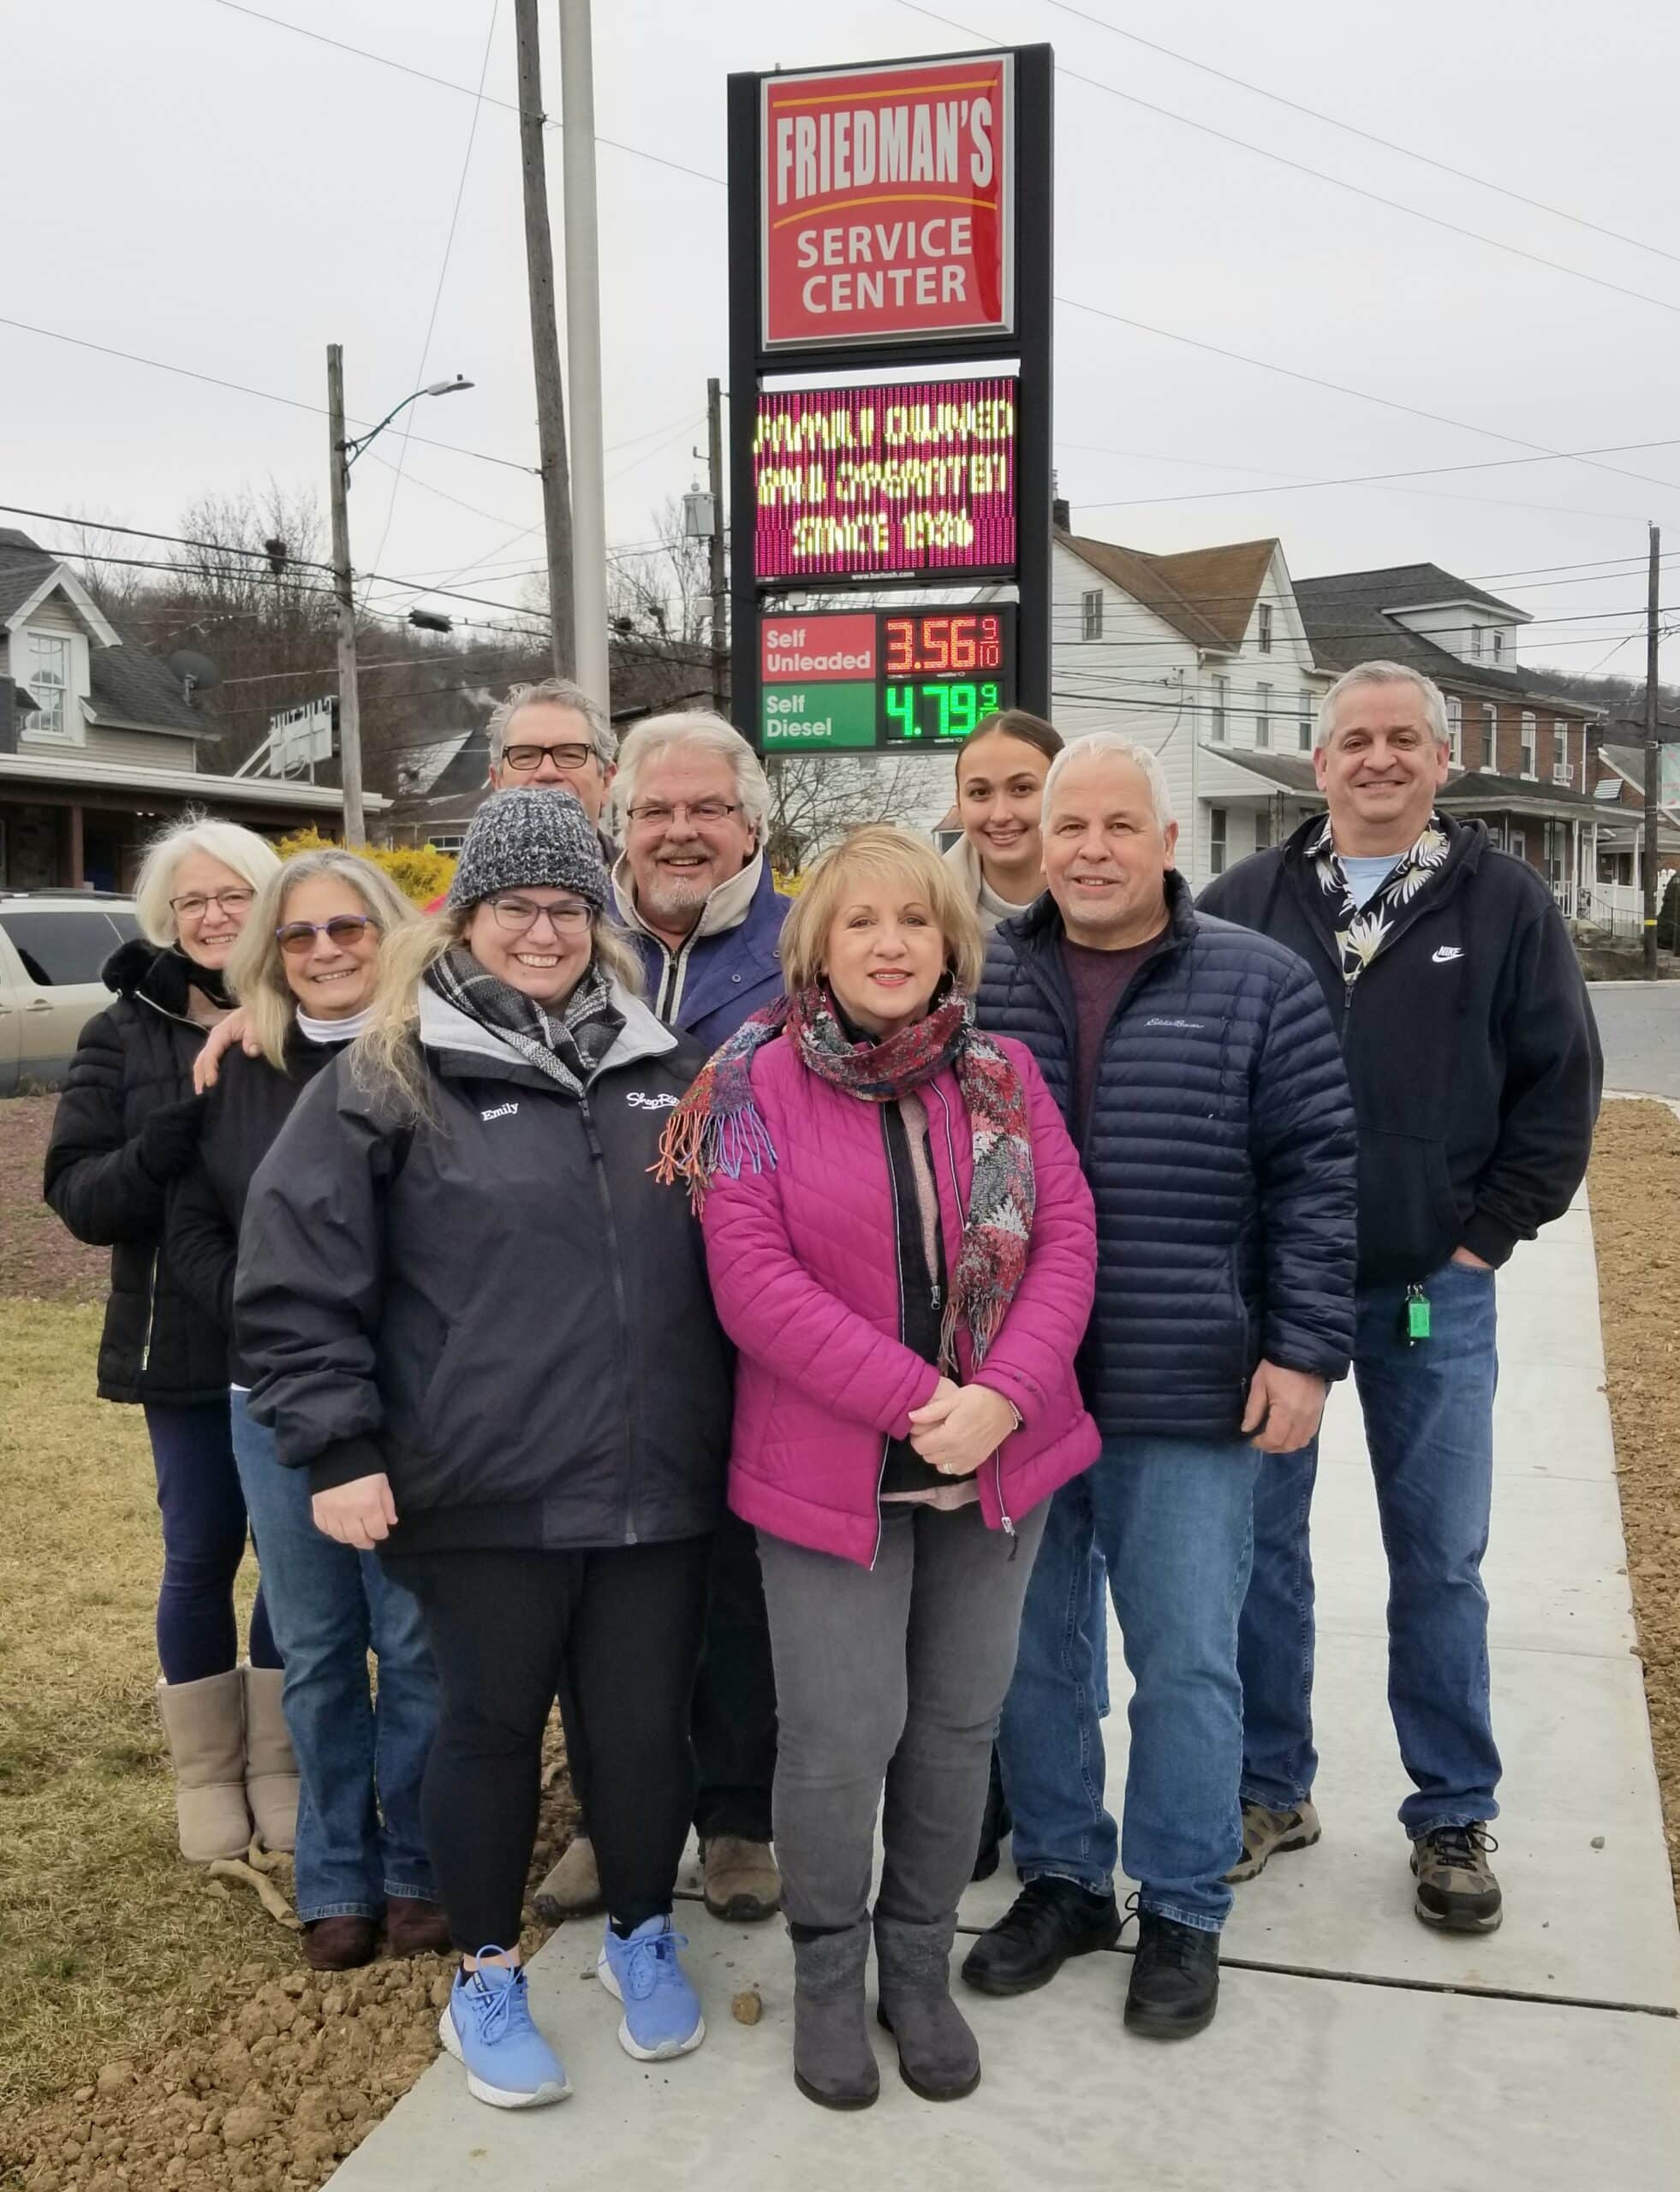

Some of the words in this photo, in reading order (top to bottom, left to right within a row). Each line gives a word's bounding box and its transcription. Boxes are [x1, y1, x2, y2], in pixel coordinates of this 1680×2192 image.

[777, 96, 993, 206] FRIEDMAN'S
[796, 216, 973, 269] SERVICE
[801, 265, 967, 314] CENTER
[766, 629, 807, 649] Self
[887, 618, 976, 670] 3.56
[766, 650, 872, 672] Unleaded
[766, 694, 806, 714] Self
[887, 684, 976, 736] 4.79
[766, 717, 832, 738] Diesel
[1439, 945, 1462, 957] NIKE
[480, 1102, 520, 1123] Emily
